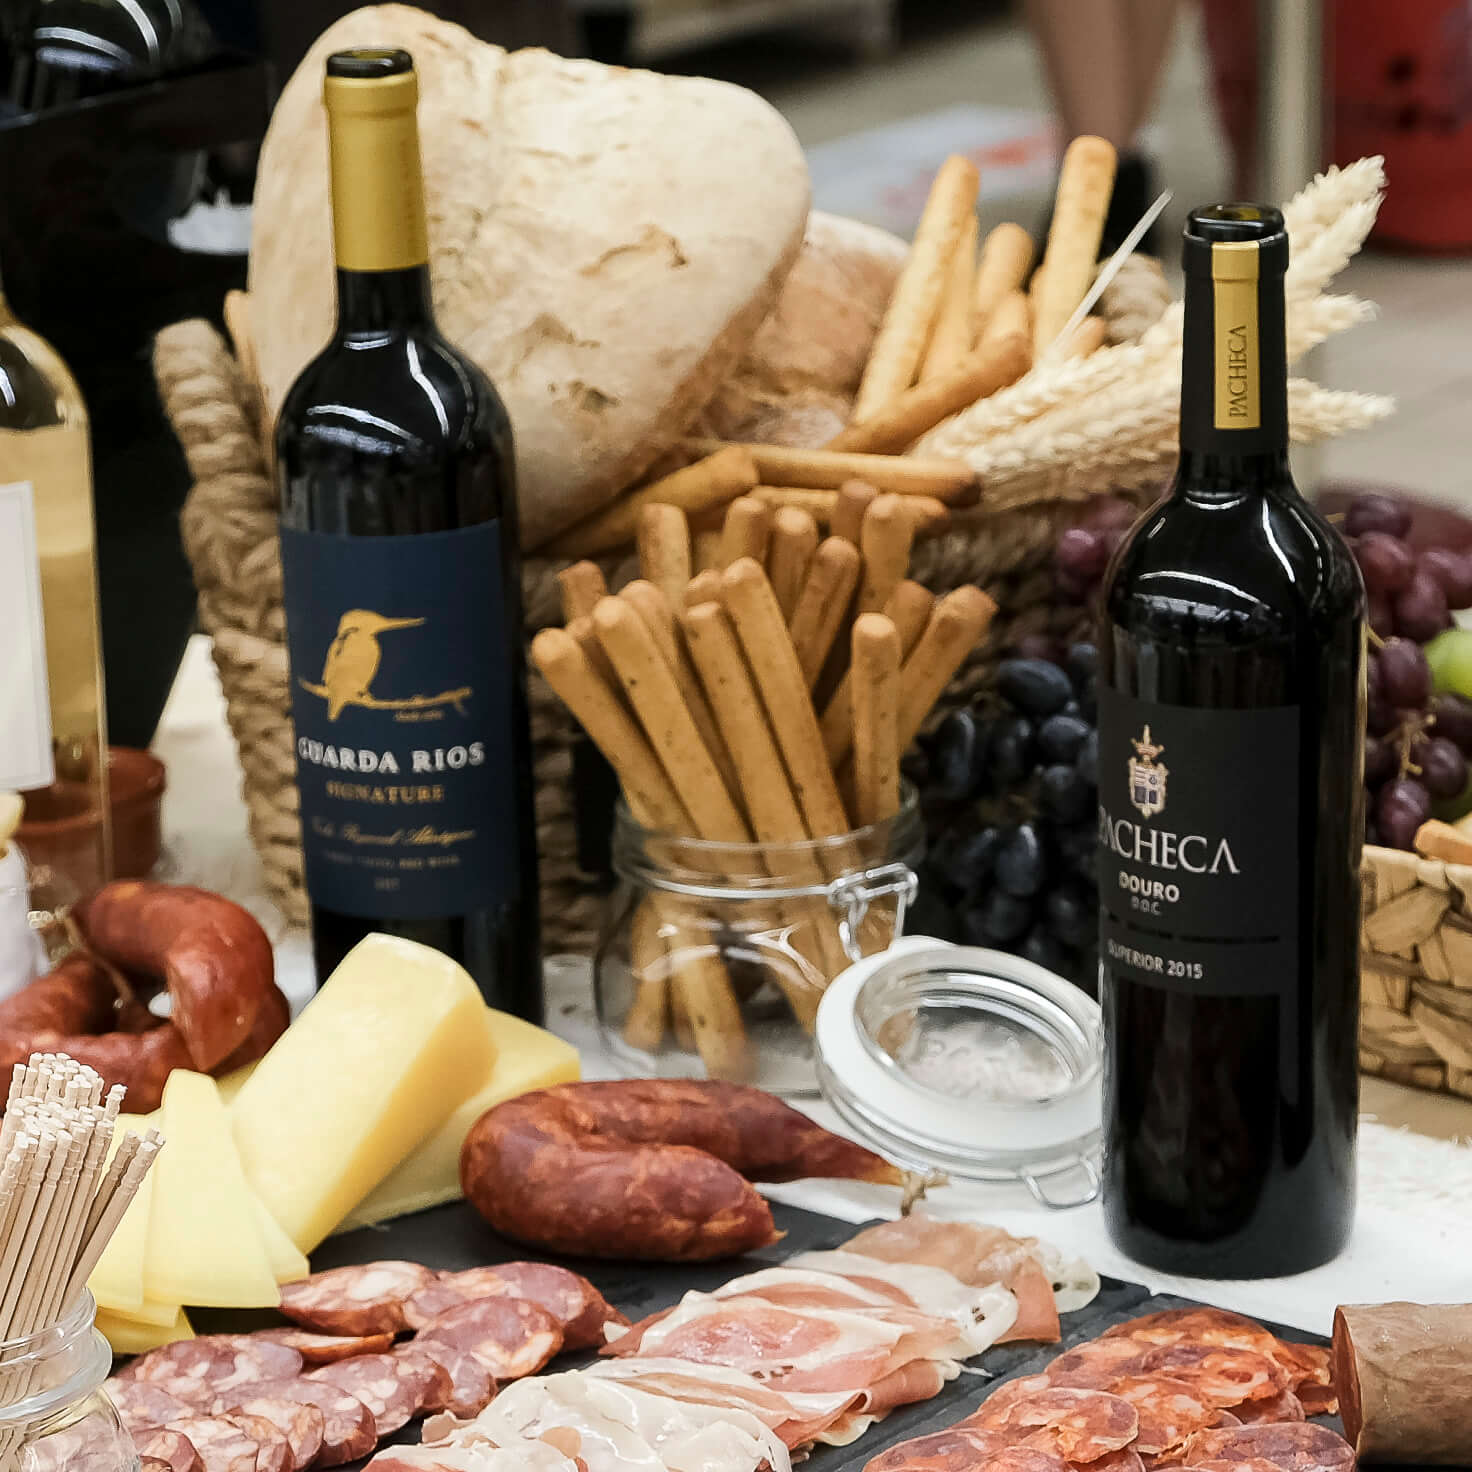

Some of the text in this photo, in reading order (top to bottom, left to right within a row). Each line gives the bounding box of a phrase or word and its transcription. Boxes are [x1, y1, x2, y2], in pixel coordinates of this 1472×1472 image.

[1228, 325, 1248, 417] PACHECA
[298, 736, 485, 774] GUARDA RIOS
[326, 780, 445, 804] SIGNATURE
[1099, 805, 1241, 874] PACHECA
[1119, 871, 1180, 903] DOURO
[1108, 938, 1204, 980] SUPERIOR 2015
